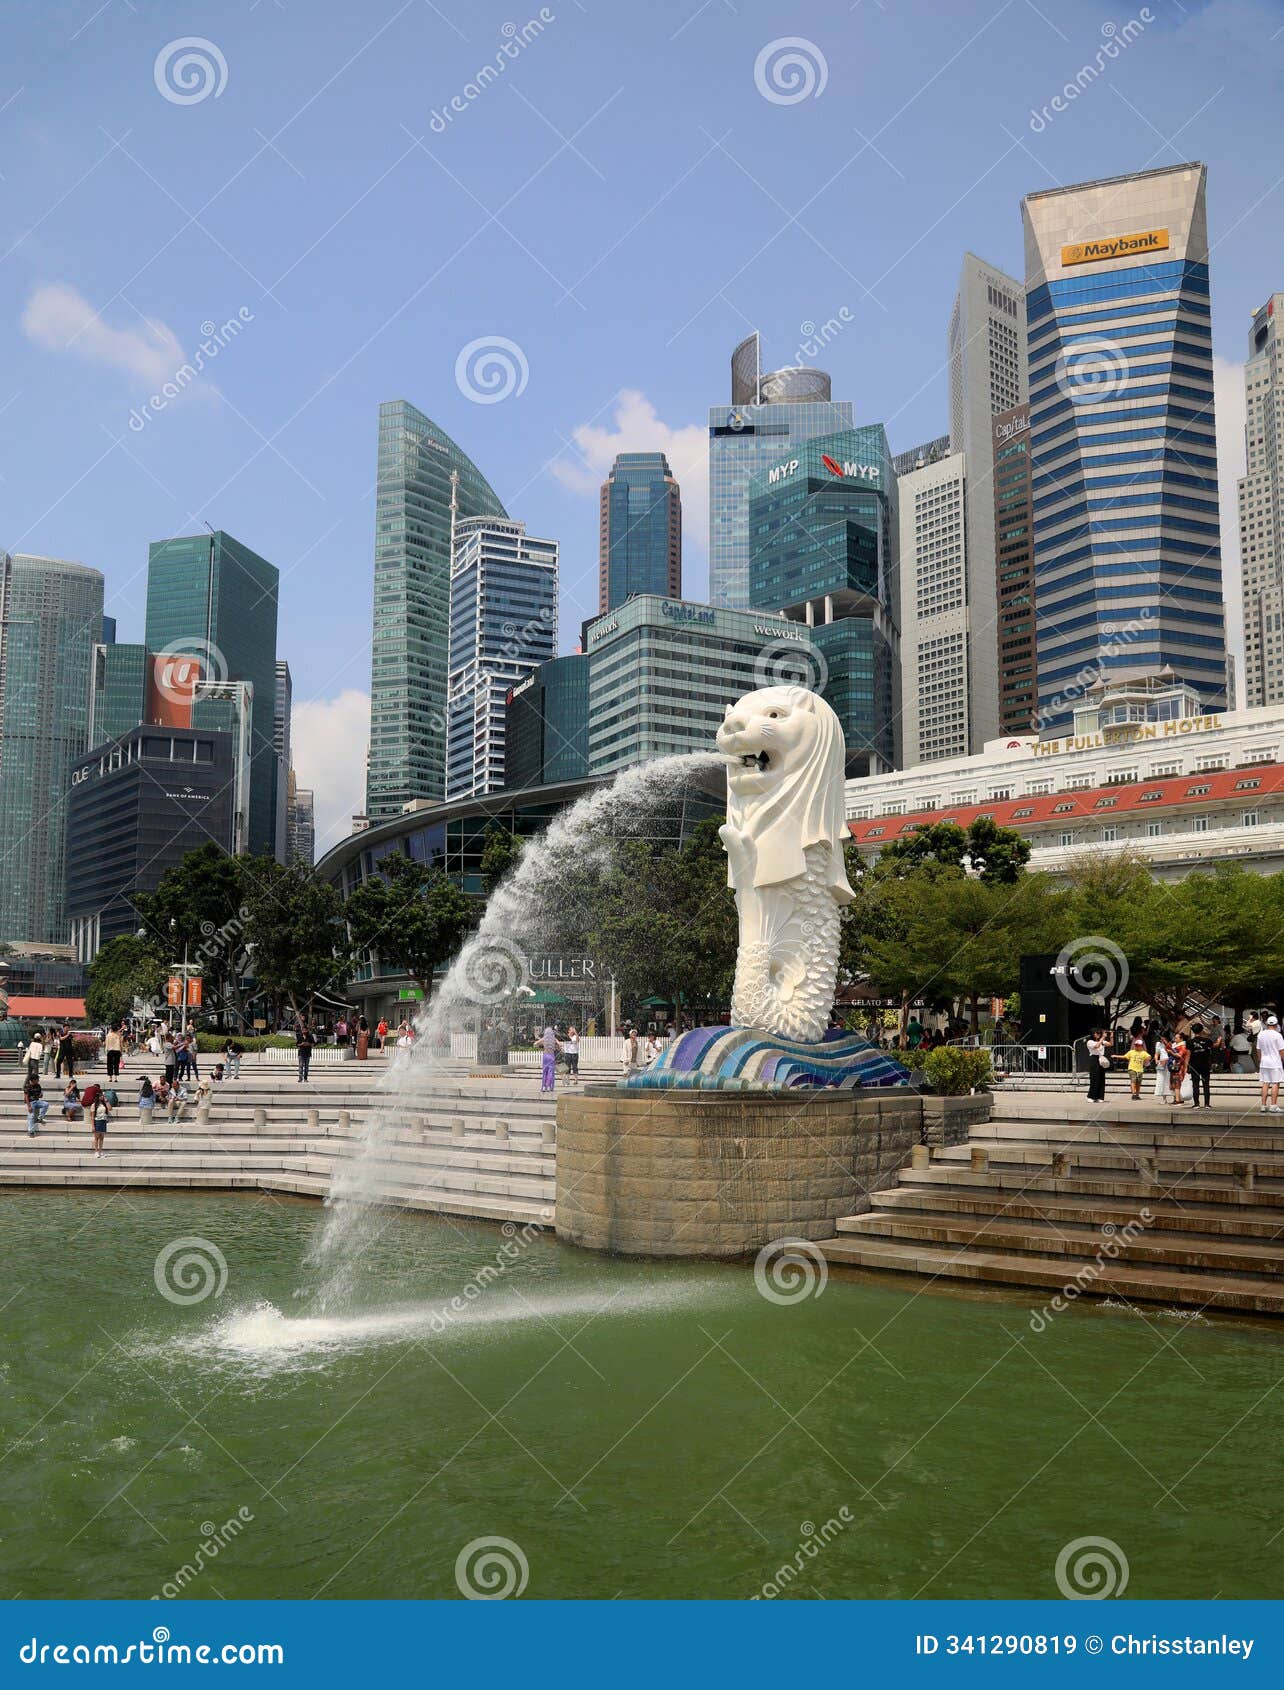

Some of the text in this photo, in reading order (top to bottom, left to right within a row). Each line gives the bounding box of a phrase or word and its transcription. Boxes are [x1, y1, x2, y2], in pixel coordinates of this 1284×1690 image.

[1084, 233, 1159, 257] Maybank
[768, 459, 799, 484] MYP
[843, 461, 880, 480] MYP
[661, 601, 715, 624] CapitaLand
[753, 624, 804, 641] wework
[1031, 714, 1222, 757] THE FULLERTON HOTEL
[522, 956, 604, 978] ULLER
